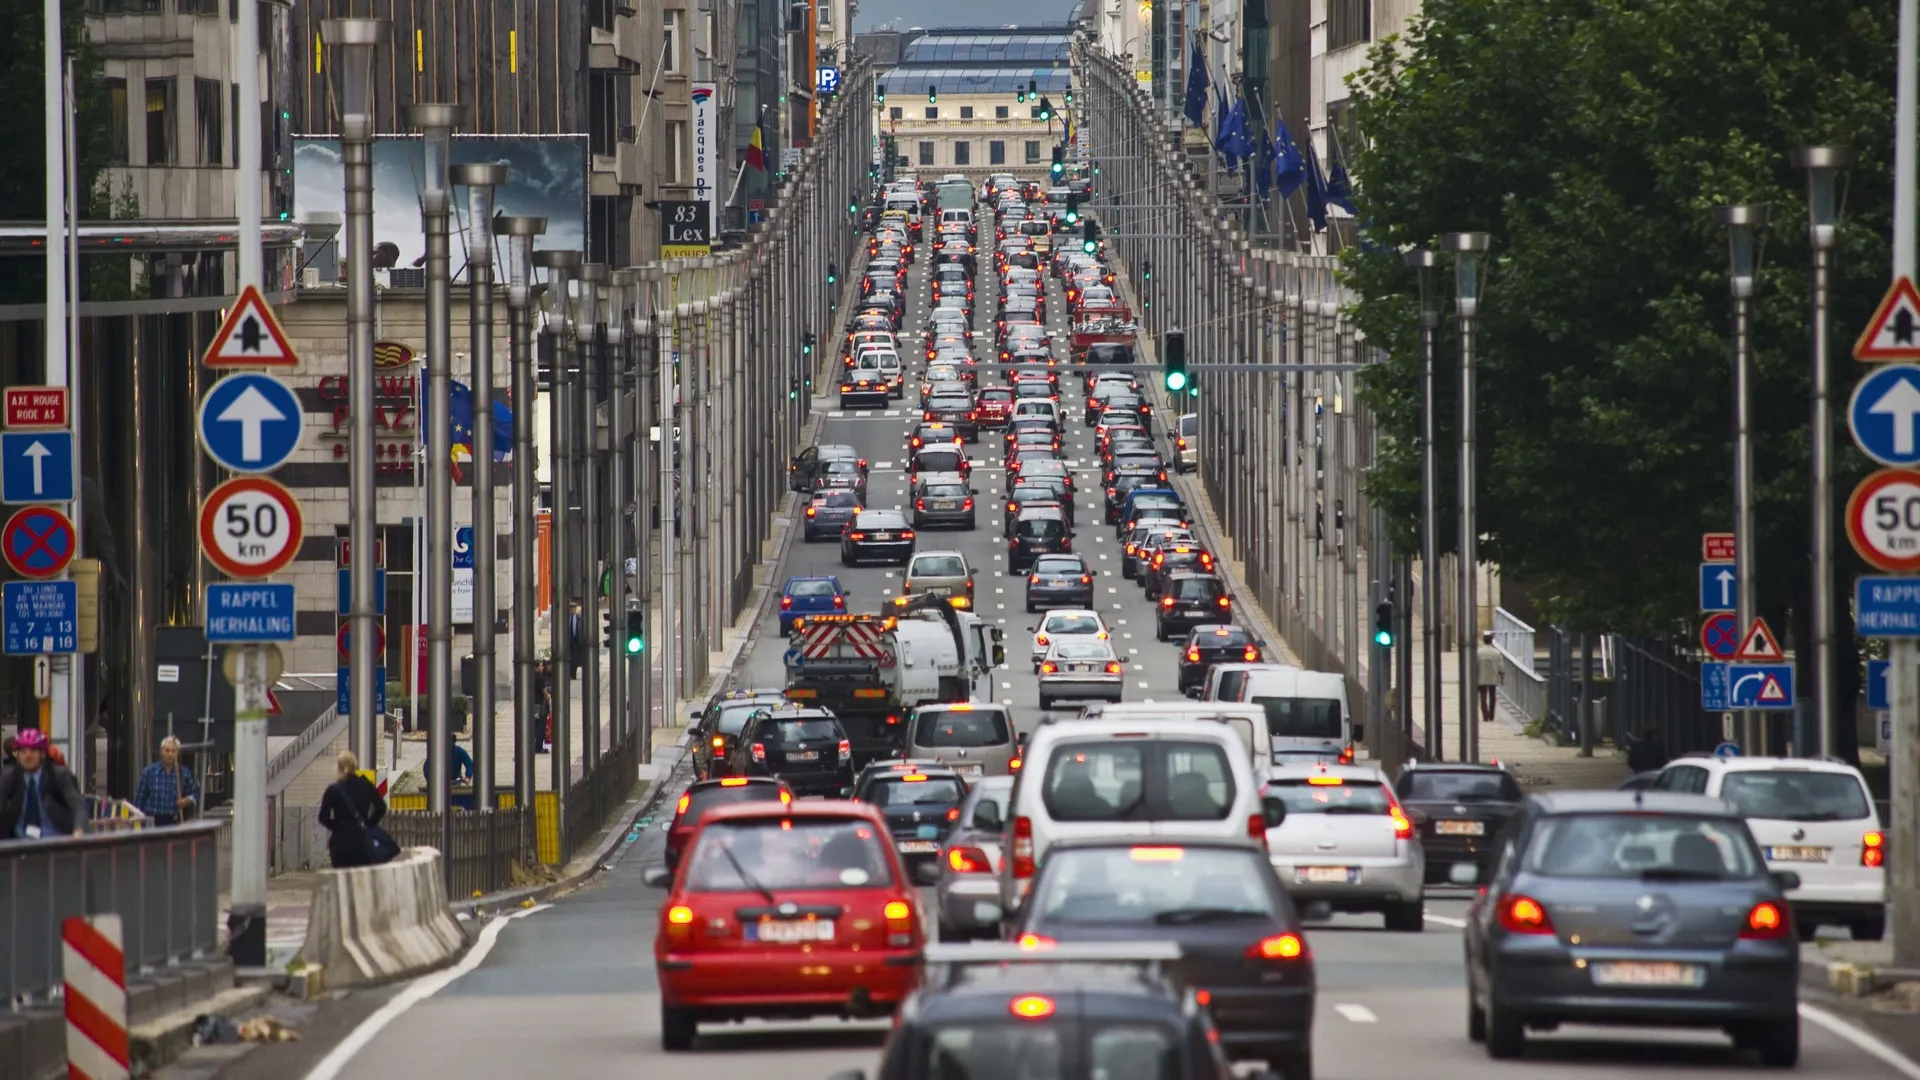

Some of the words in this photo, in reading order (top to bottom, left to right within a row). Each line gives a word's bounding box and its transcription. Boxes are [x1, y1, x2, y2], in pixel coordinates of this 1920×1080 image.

[697, 108, 705, 173] Jacques
[696, 178, 706, 201] De
[674, 205, 697, 223] 83
[668, 224, 704, 241] Lex
[12, 396, 28, 406] AXE
[32, 394, 60, 406] ROUGE
[16, 409, 38, 420] RODE
[44, 408, 56, 420] AS
[226, 504, 277, 538] 50
[1875, 496, 1920, 531] 50
[238, 541, 266, 557] km
[1887, 535, 1917, 549] km
[220, 590, 278, 608] RAPPEL
[27, 622, 35, 634] 7
[59, 620, 72, 633] 13
[210, 616, 291, 634] HERHALING
[24, 638, 38, 650] 16
[59, 636, 72, 649] 18
